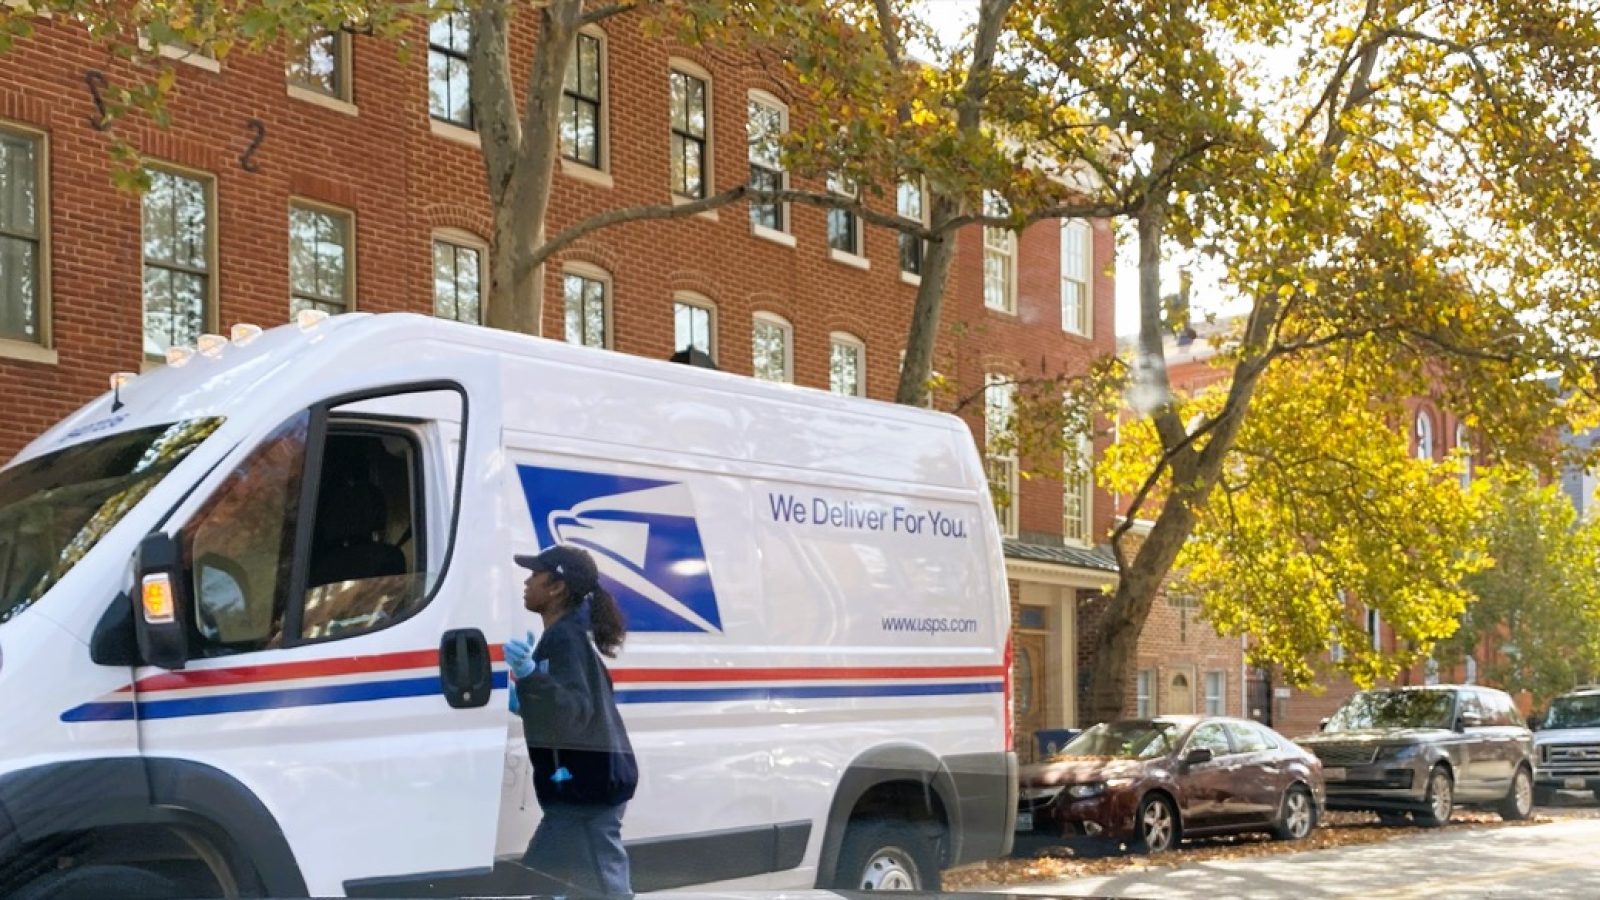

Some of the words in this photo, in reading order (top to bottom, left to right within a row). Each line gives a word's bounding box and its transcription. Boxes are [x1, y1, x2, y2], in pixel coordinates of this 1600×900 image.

[769, 493, 806, 525] We
[812, 498, 886, 531] Deliver
[893, 506, 925, 534] For
[928, 510, 967, 538] You.
[882, 616, 977, 635] www.usps.com
